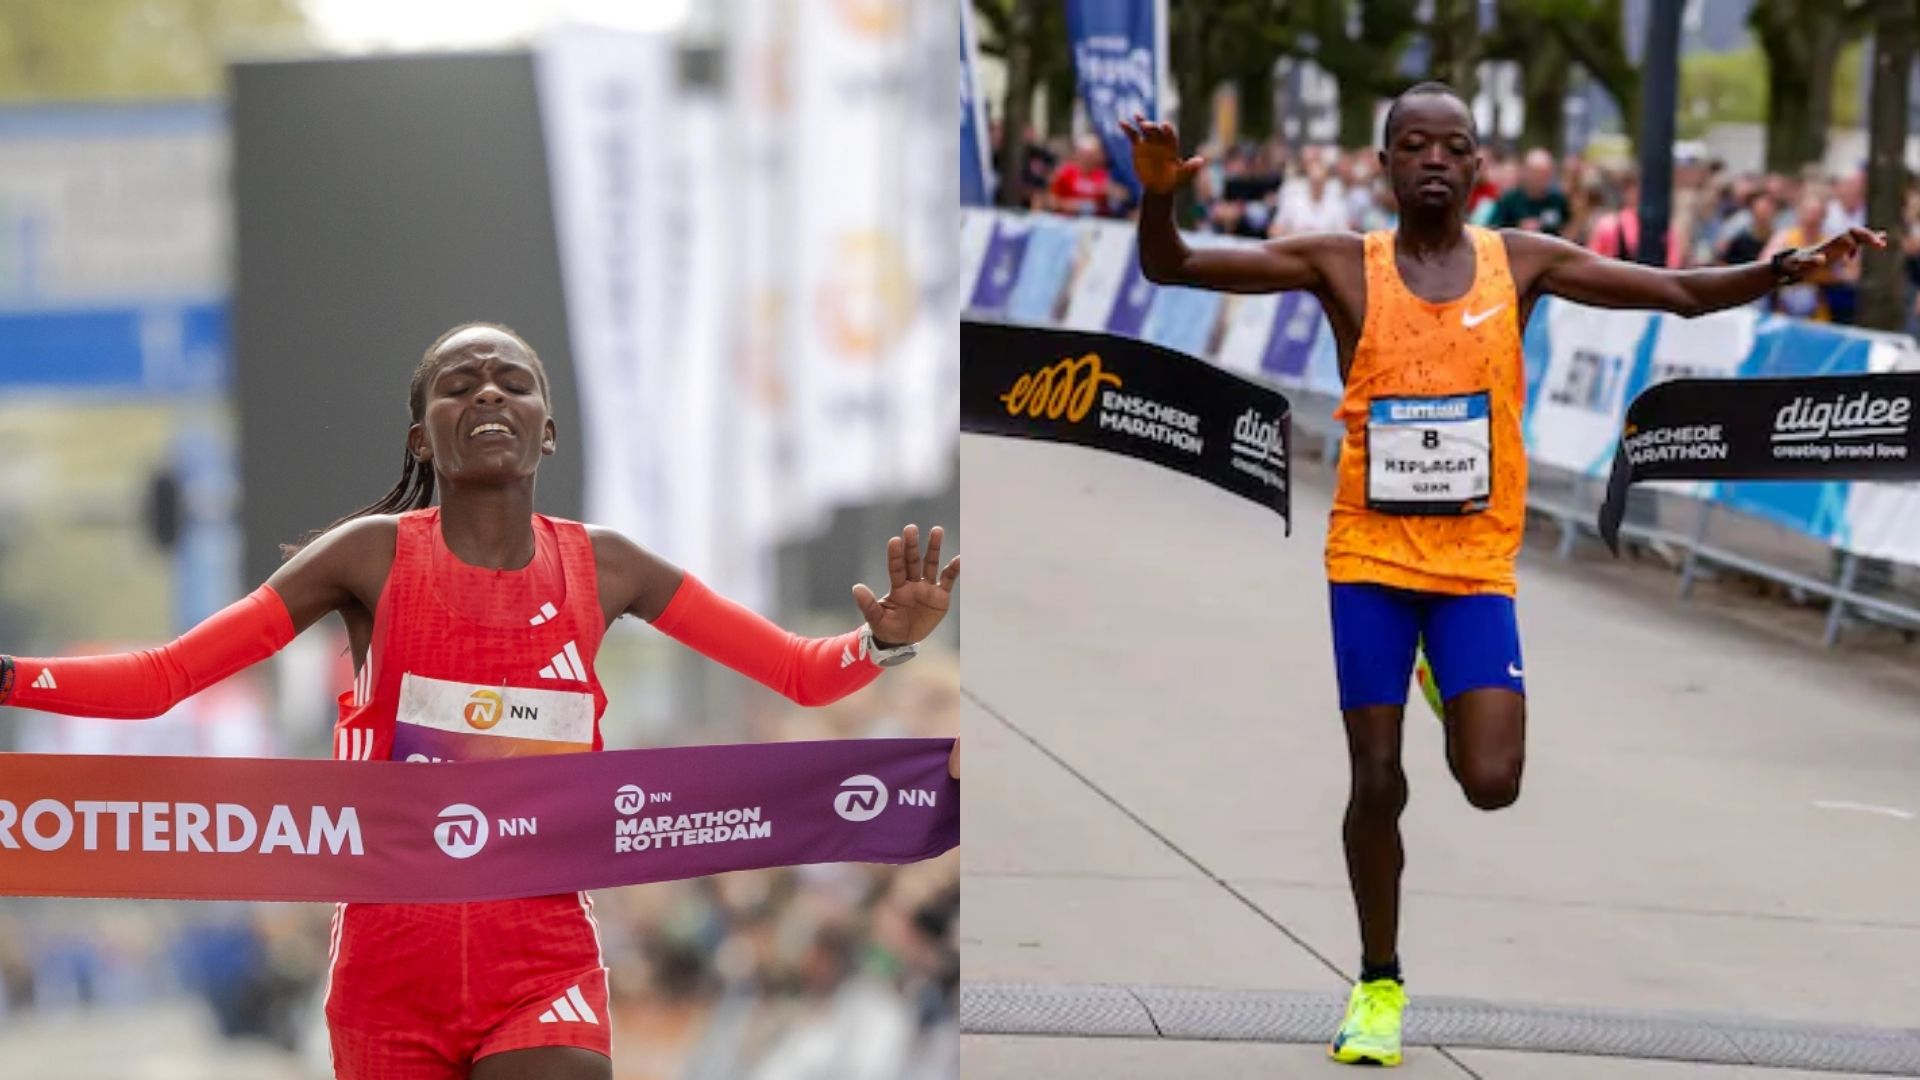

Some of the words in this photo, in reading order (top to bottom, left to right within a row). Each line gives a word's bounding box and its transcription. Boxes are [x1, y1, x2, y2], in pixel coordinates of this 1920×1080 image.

[1102, 390, 1199, 434] ENSCHEDE
[1774, 391, 1911, 437] digidee
[1100, 411, 1204, 455] MARATHON
[1422, 429, 1439, 449] 8
[1627, 442, 1729, 465] ARATHON
[1773, 442, 1832, 461] creating
[1834, 442, 1874, 459] brand
[1876, 442, 1907, 459] love
[510, 705, 538, 721] NN
[650, 791, 672, 803] NN
[898, 789, 936, 807] NN
[0, 799, 364, 856] ROTTERDAM
[498, 817, 537, 837] NN
[615, 807, 761, 836] MARATHON
[615, 821, 772, 853] ROTTERDAM
